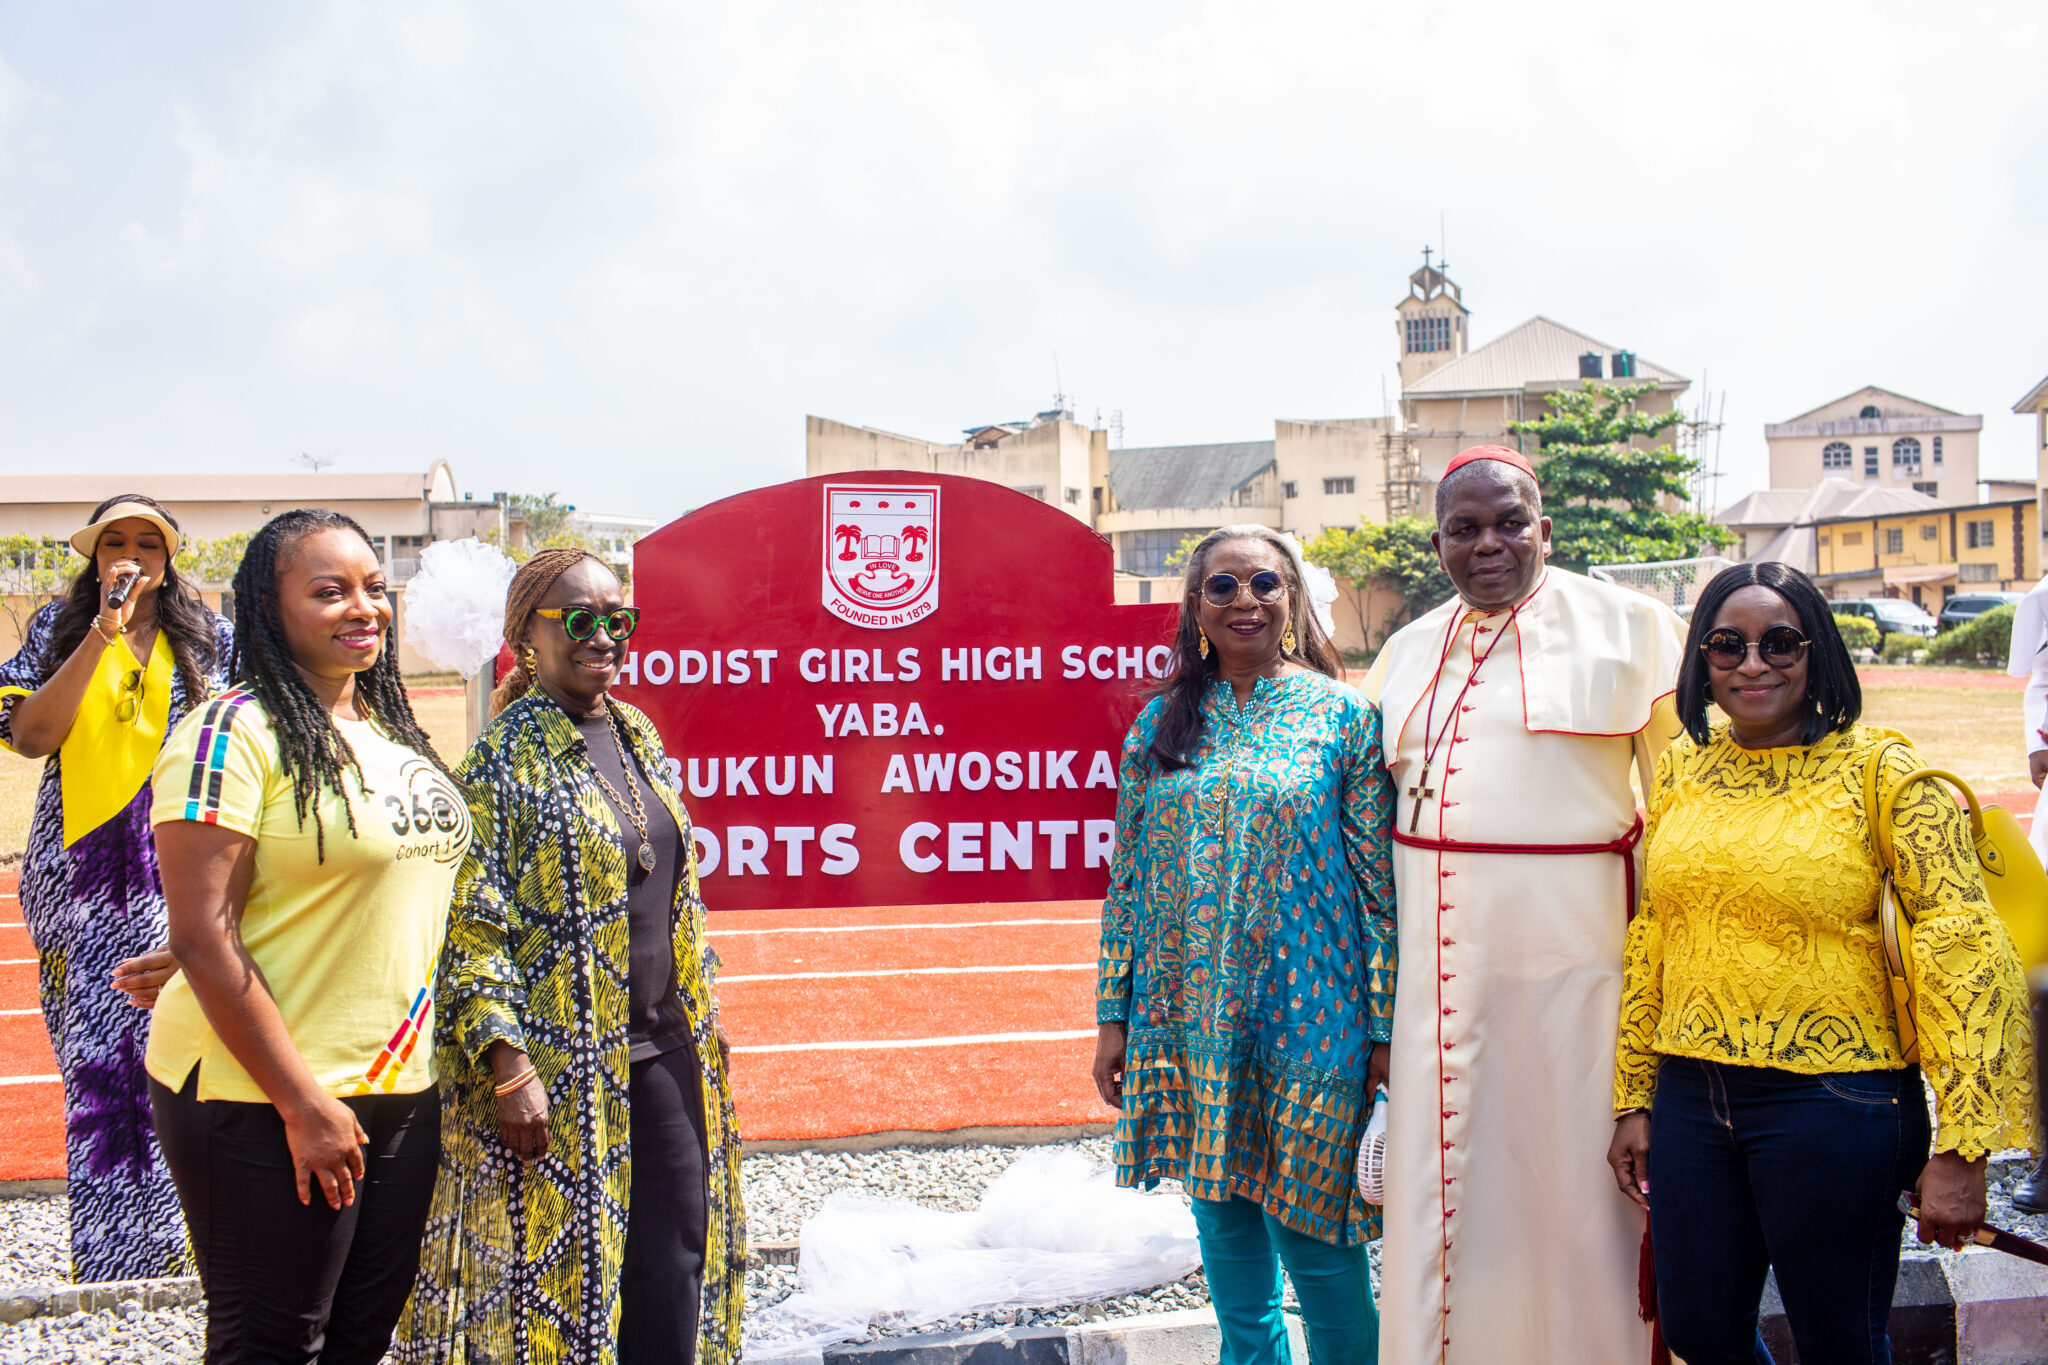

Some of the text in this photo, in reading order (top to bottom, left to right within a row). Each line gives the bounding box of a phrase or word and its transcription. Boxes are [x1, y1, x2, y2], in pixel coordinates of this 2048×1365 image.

[856, 586, 908, 599] SERVE ONE ANOTHER
[830, 598, 932, 626] FOUNDED IN 1879
[799, 647, 921, 683] GIRLS
[941, 646, 1042, 681] HIGH
[1061, 644, 1181, 680] SCHO
[815, 702, 944, 738] YABA.
[880, 750, 1118, 793] AWOSIKA
[396, 841, 440, 861] Cohort
